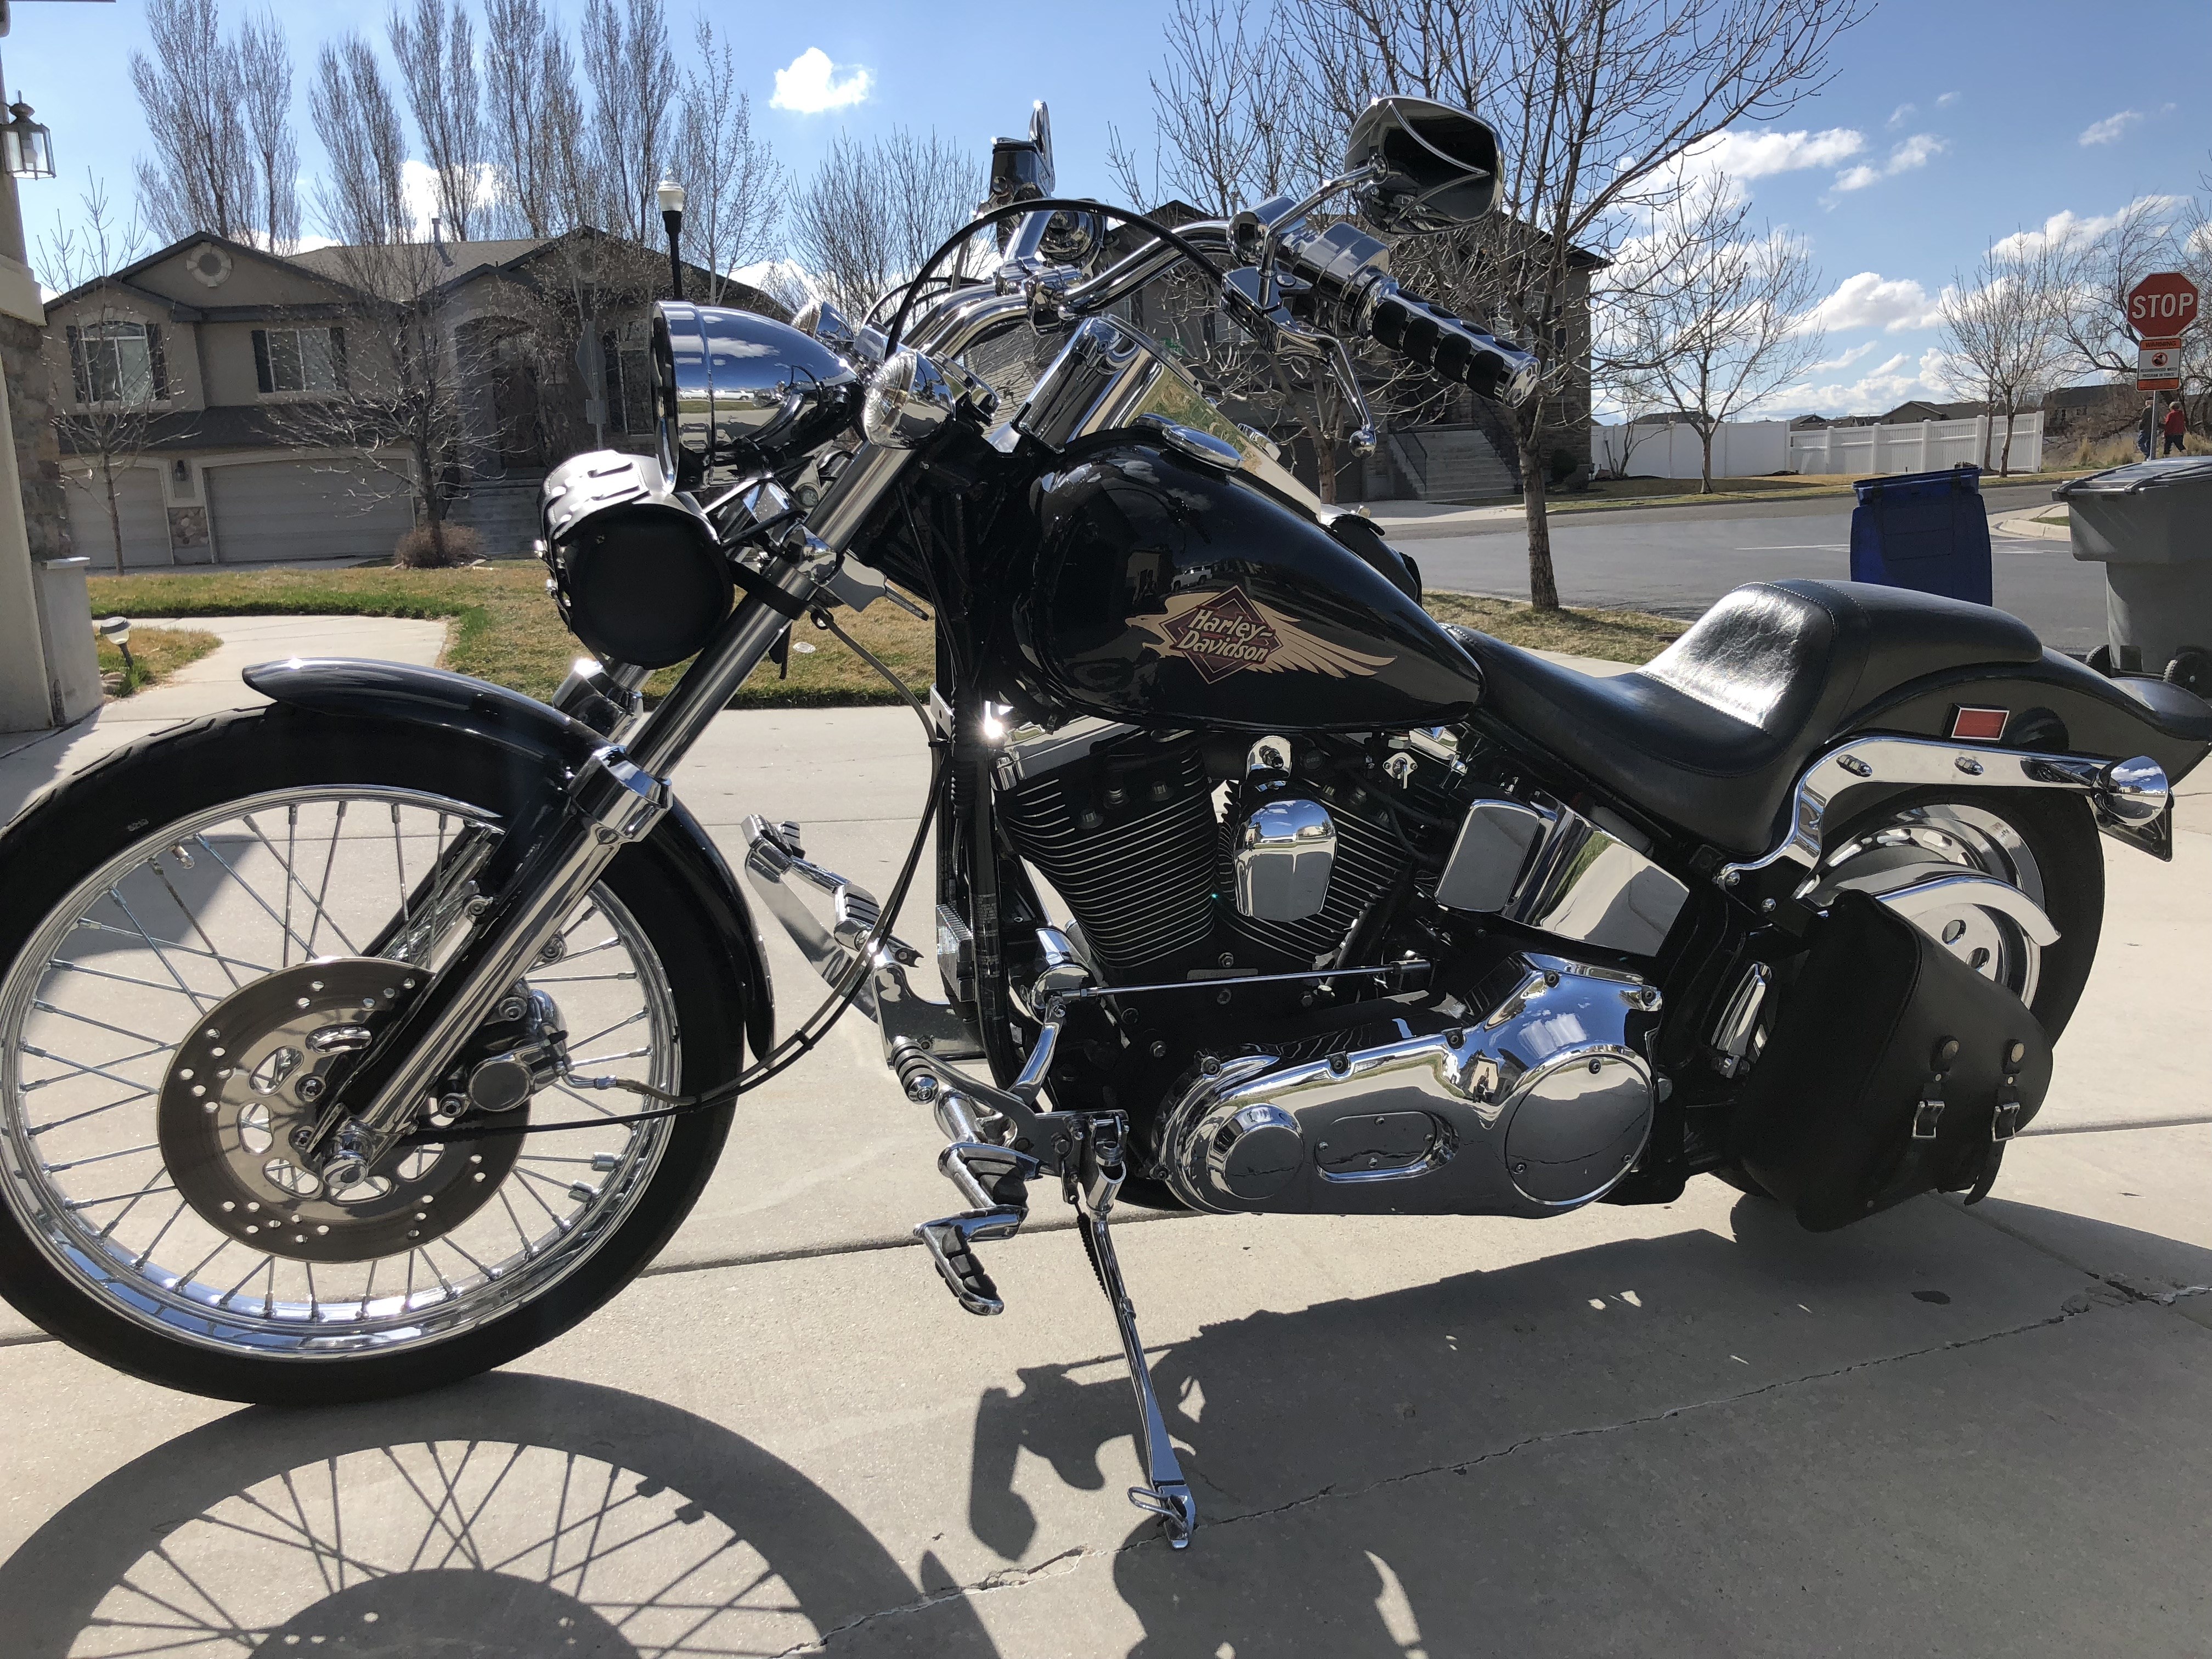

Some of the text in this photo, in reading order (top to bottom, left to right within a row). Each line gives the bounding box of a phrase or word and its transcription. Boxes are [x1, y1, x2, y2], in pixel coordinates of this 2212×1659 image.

[2132, 293, 2194, 319] STOP
[1188, 609, 1273, 641] Harley-
[1177, 630, 1269, 661] Davidson
